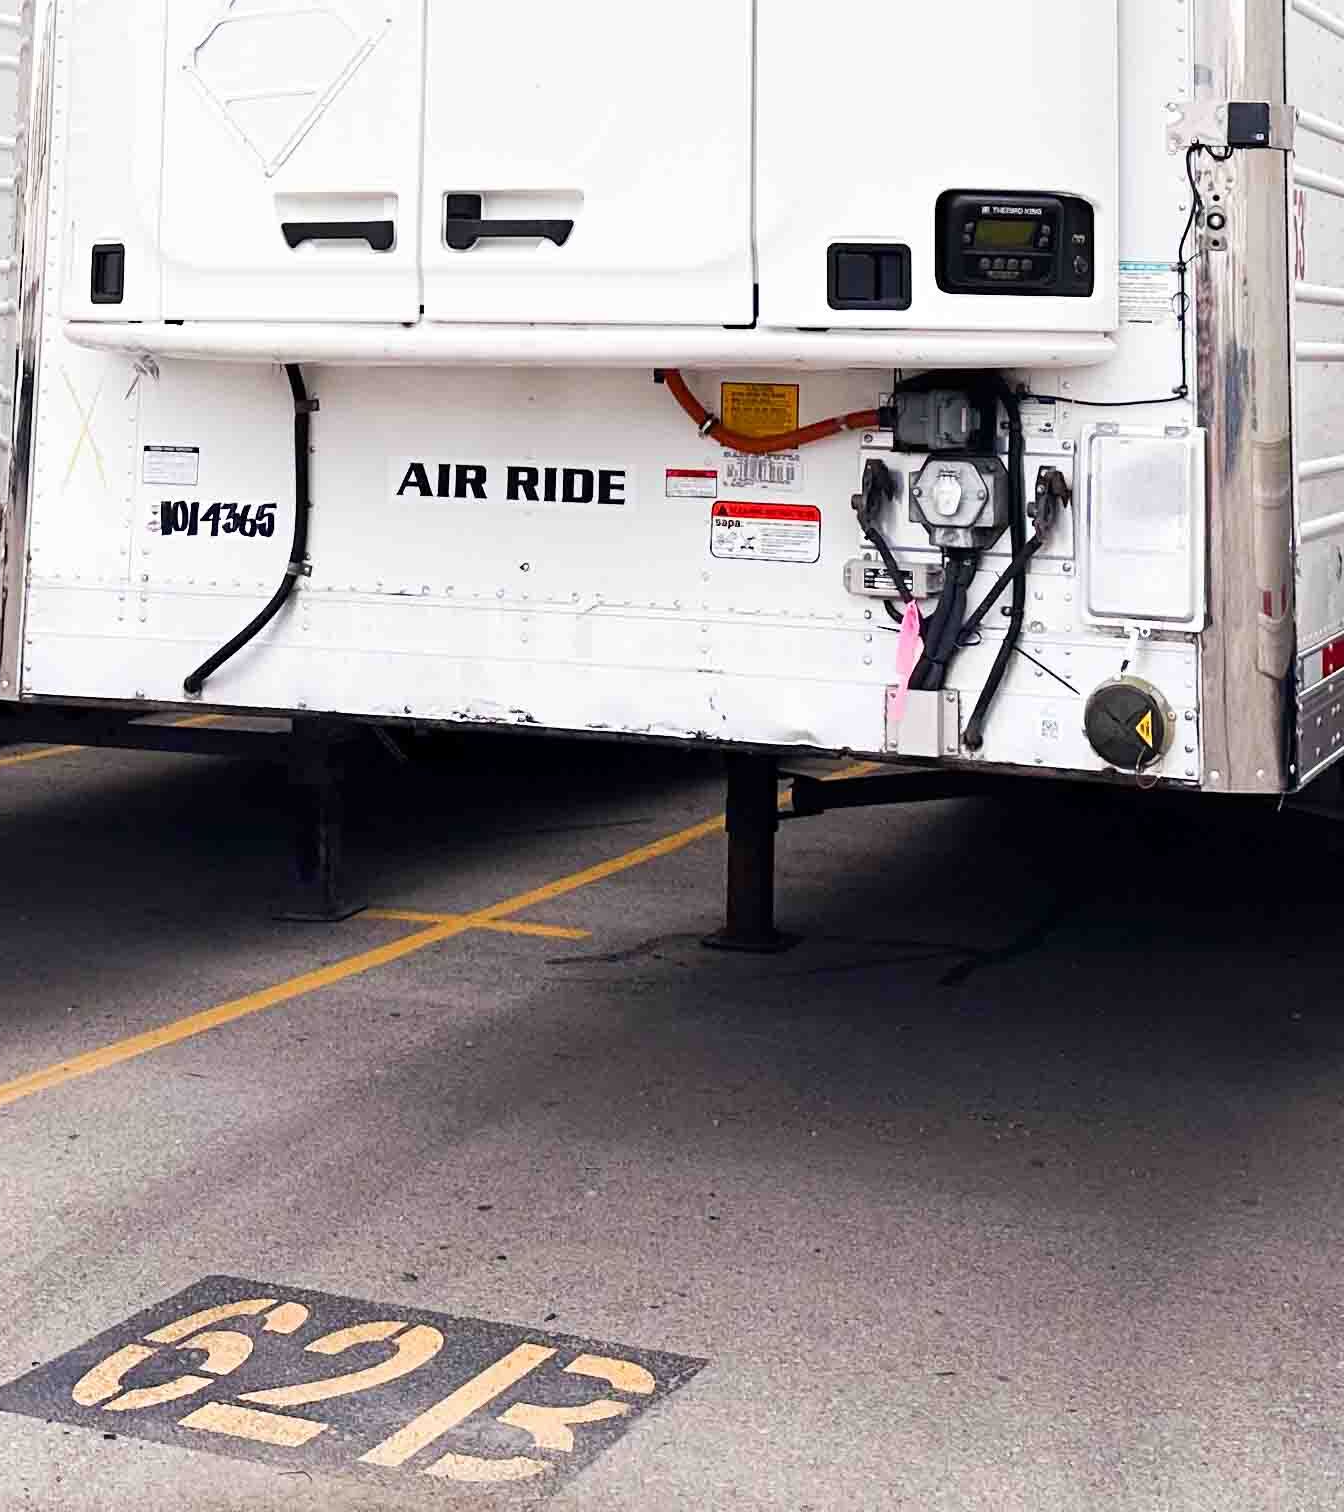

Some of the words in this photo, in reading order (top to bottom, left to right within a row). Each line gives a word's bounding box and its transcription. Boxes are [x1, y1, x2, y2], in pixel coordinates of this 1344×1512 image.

[396, 462, 488, 499] AIR
[506, 466, 626, 505] RIDE
[72, 1299, 657, 1482] 62B
